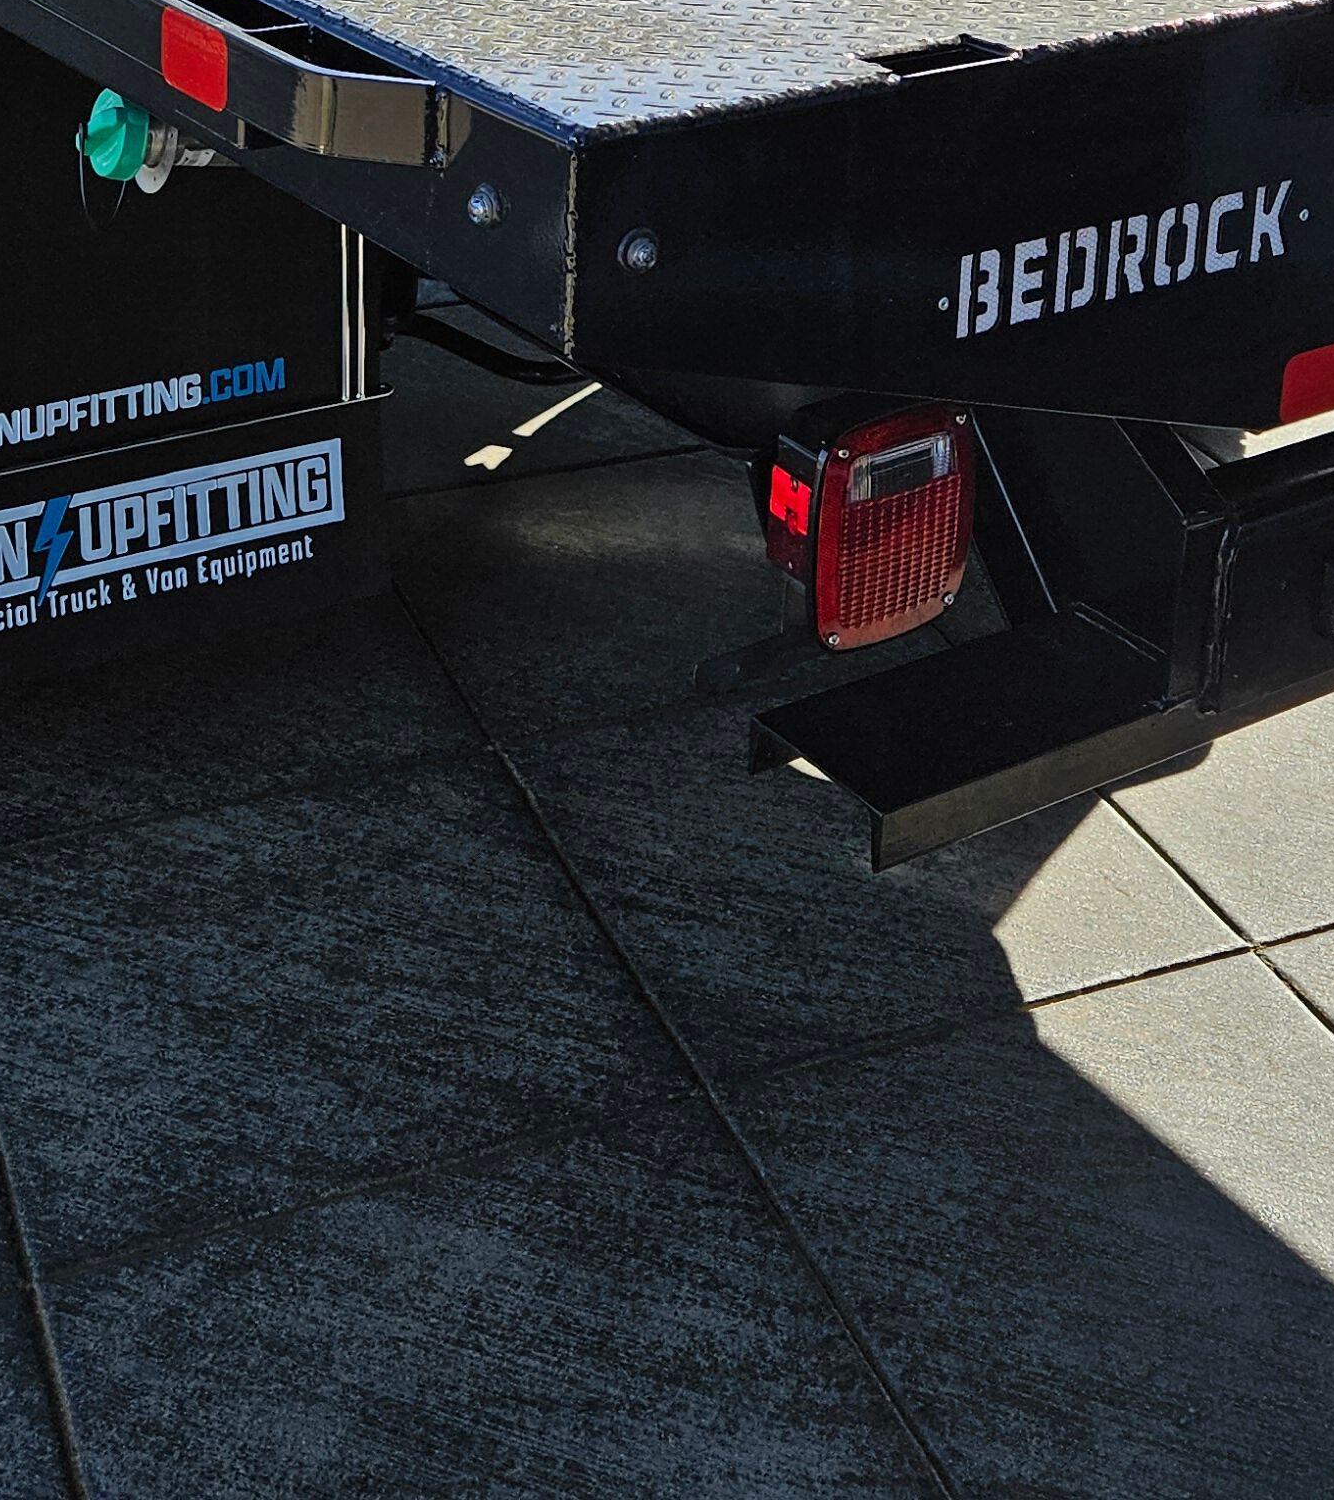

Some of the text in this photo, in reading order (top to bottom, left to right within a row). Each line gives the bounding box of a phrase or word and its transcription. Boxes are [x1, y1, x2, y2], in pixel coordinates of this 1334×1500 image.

[956, 180, 1292, 339] BEDROCK
[78, 457, 329, 561] UPFITTING
[47, 582, 113, 618] Truck
[122, 573, 137, 601] &
[146, 566, 189, 596] Van
[197, 534, 314, 585] Equipment
